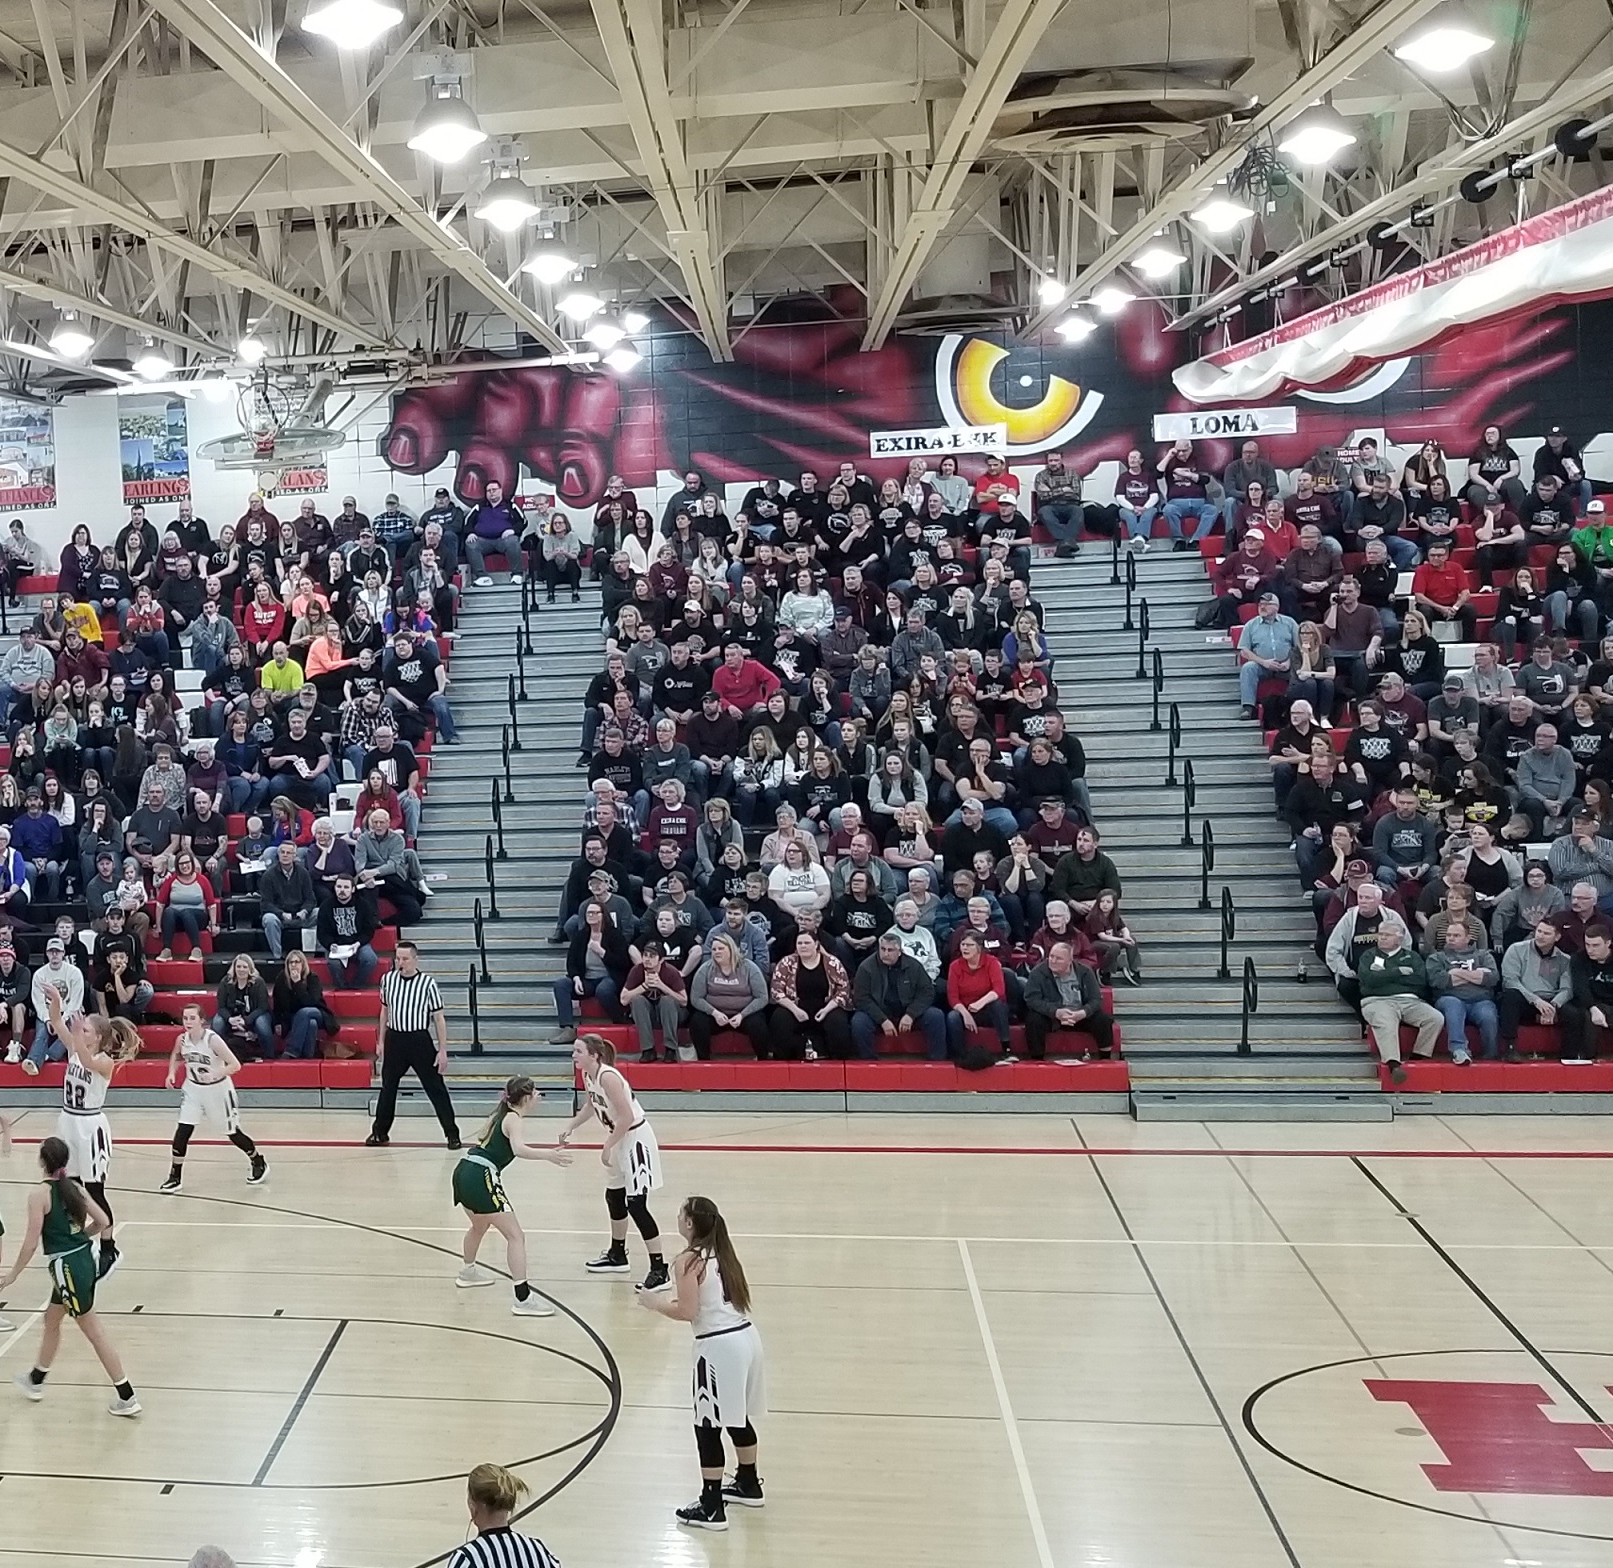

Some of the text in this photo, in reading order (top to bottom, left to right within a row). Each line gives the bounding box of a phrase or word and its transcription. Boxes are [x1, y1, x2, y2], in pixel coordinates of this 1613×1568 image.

[1189, 411, 1260, 435] LOMA
[124, 480, 180, 497] EARLING
[125, 496, 156, 505] JOINED
[158, 495, 170, 503] AS
[65, 1079, 86, 1109] 22
